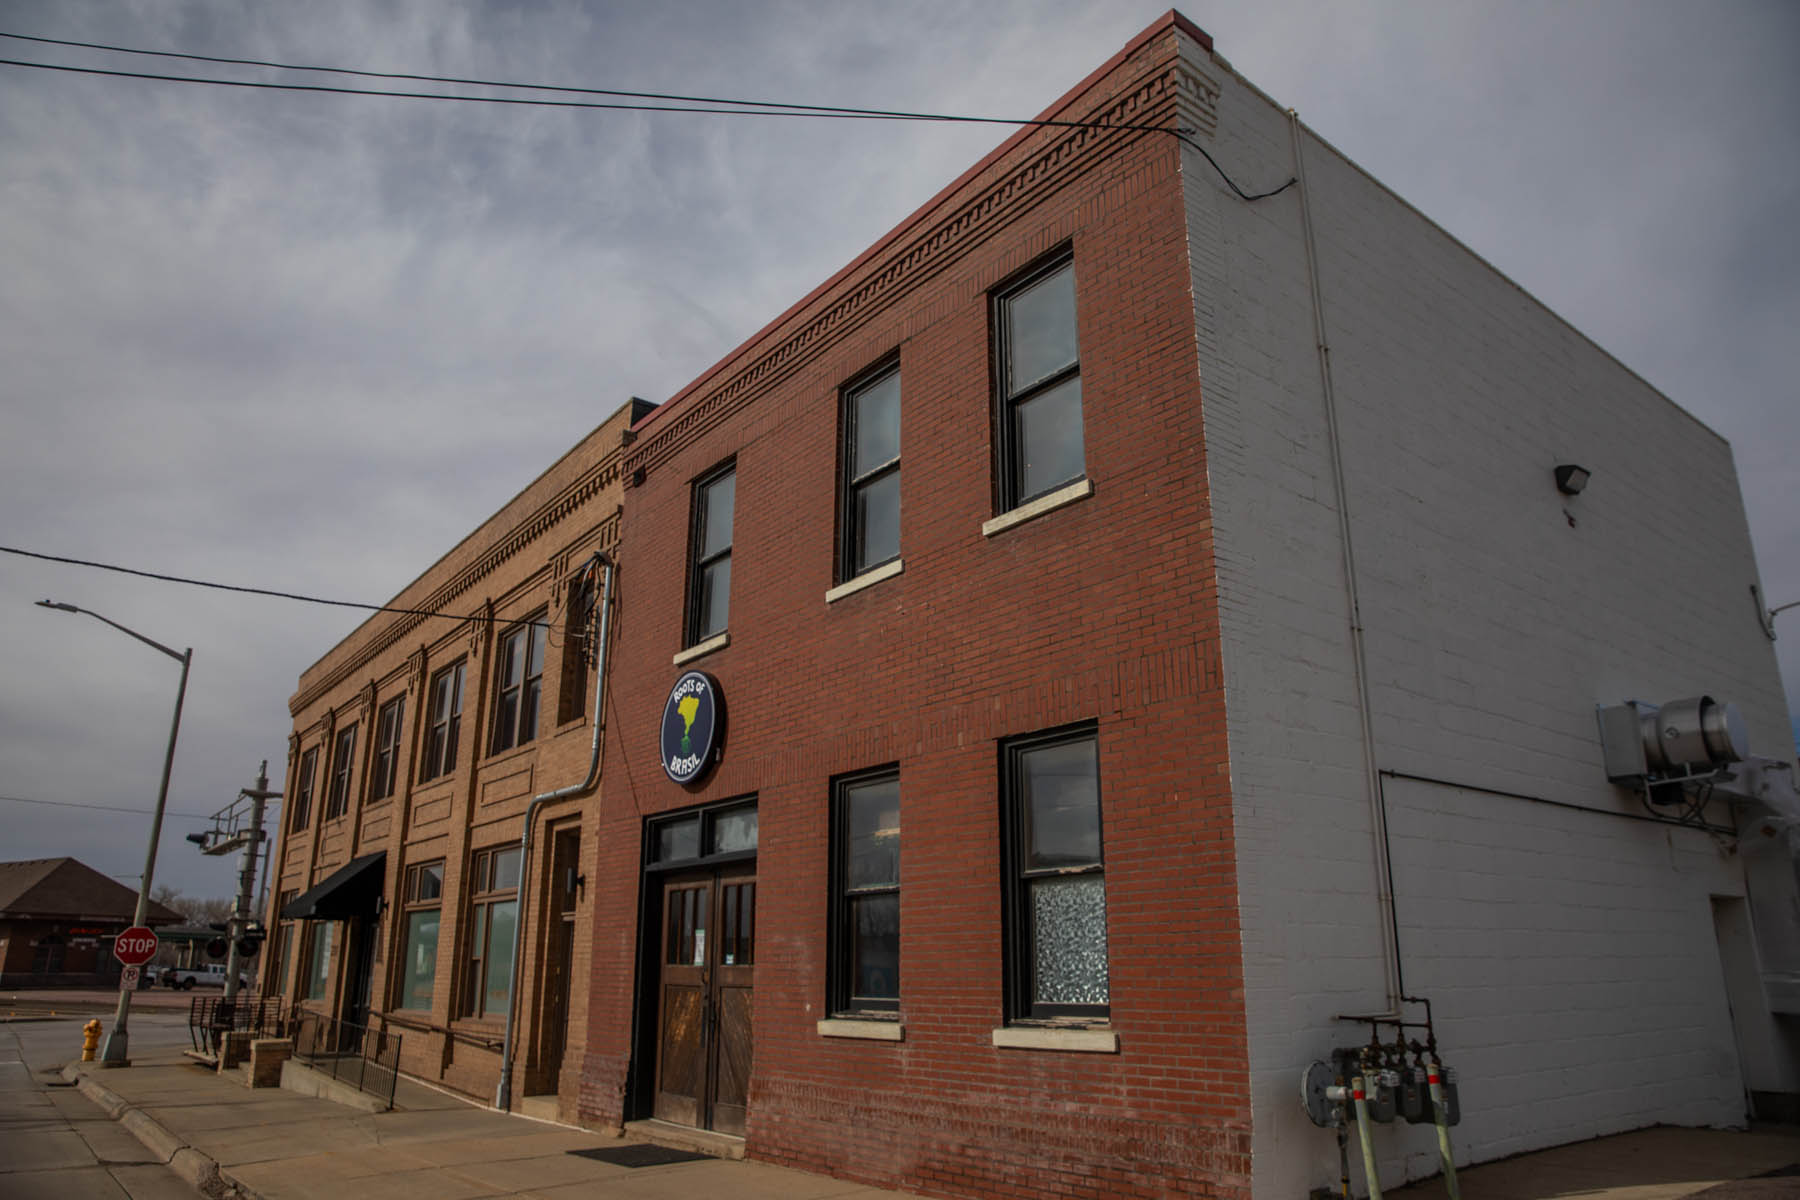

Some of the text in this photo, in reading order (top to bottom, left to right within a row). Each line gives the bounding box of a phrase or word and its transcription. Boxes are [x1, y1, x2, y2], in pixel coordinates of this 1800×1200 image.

[673, 679, 705, 703] ROOTS OF
[670, 753, 701, 775] BRASIL
[117, 938, 155, 953] STOP
